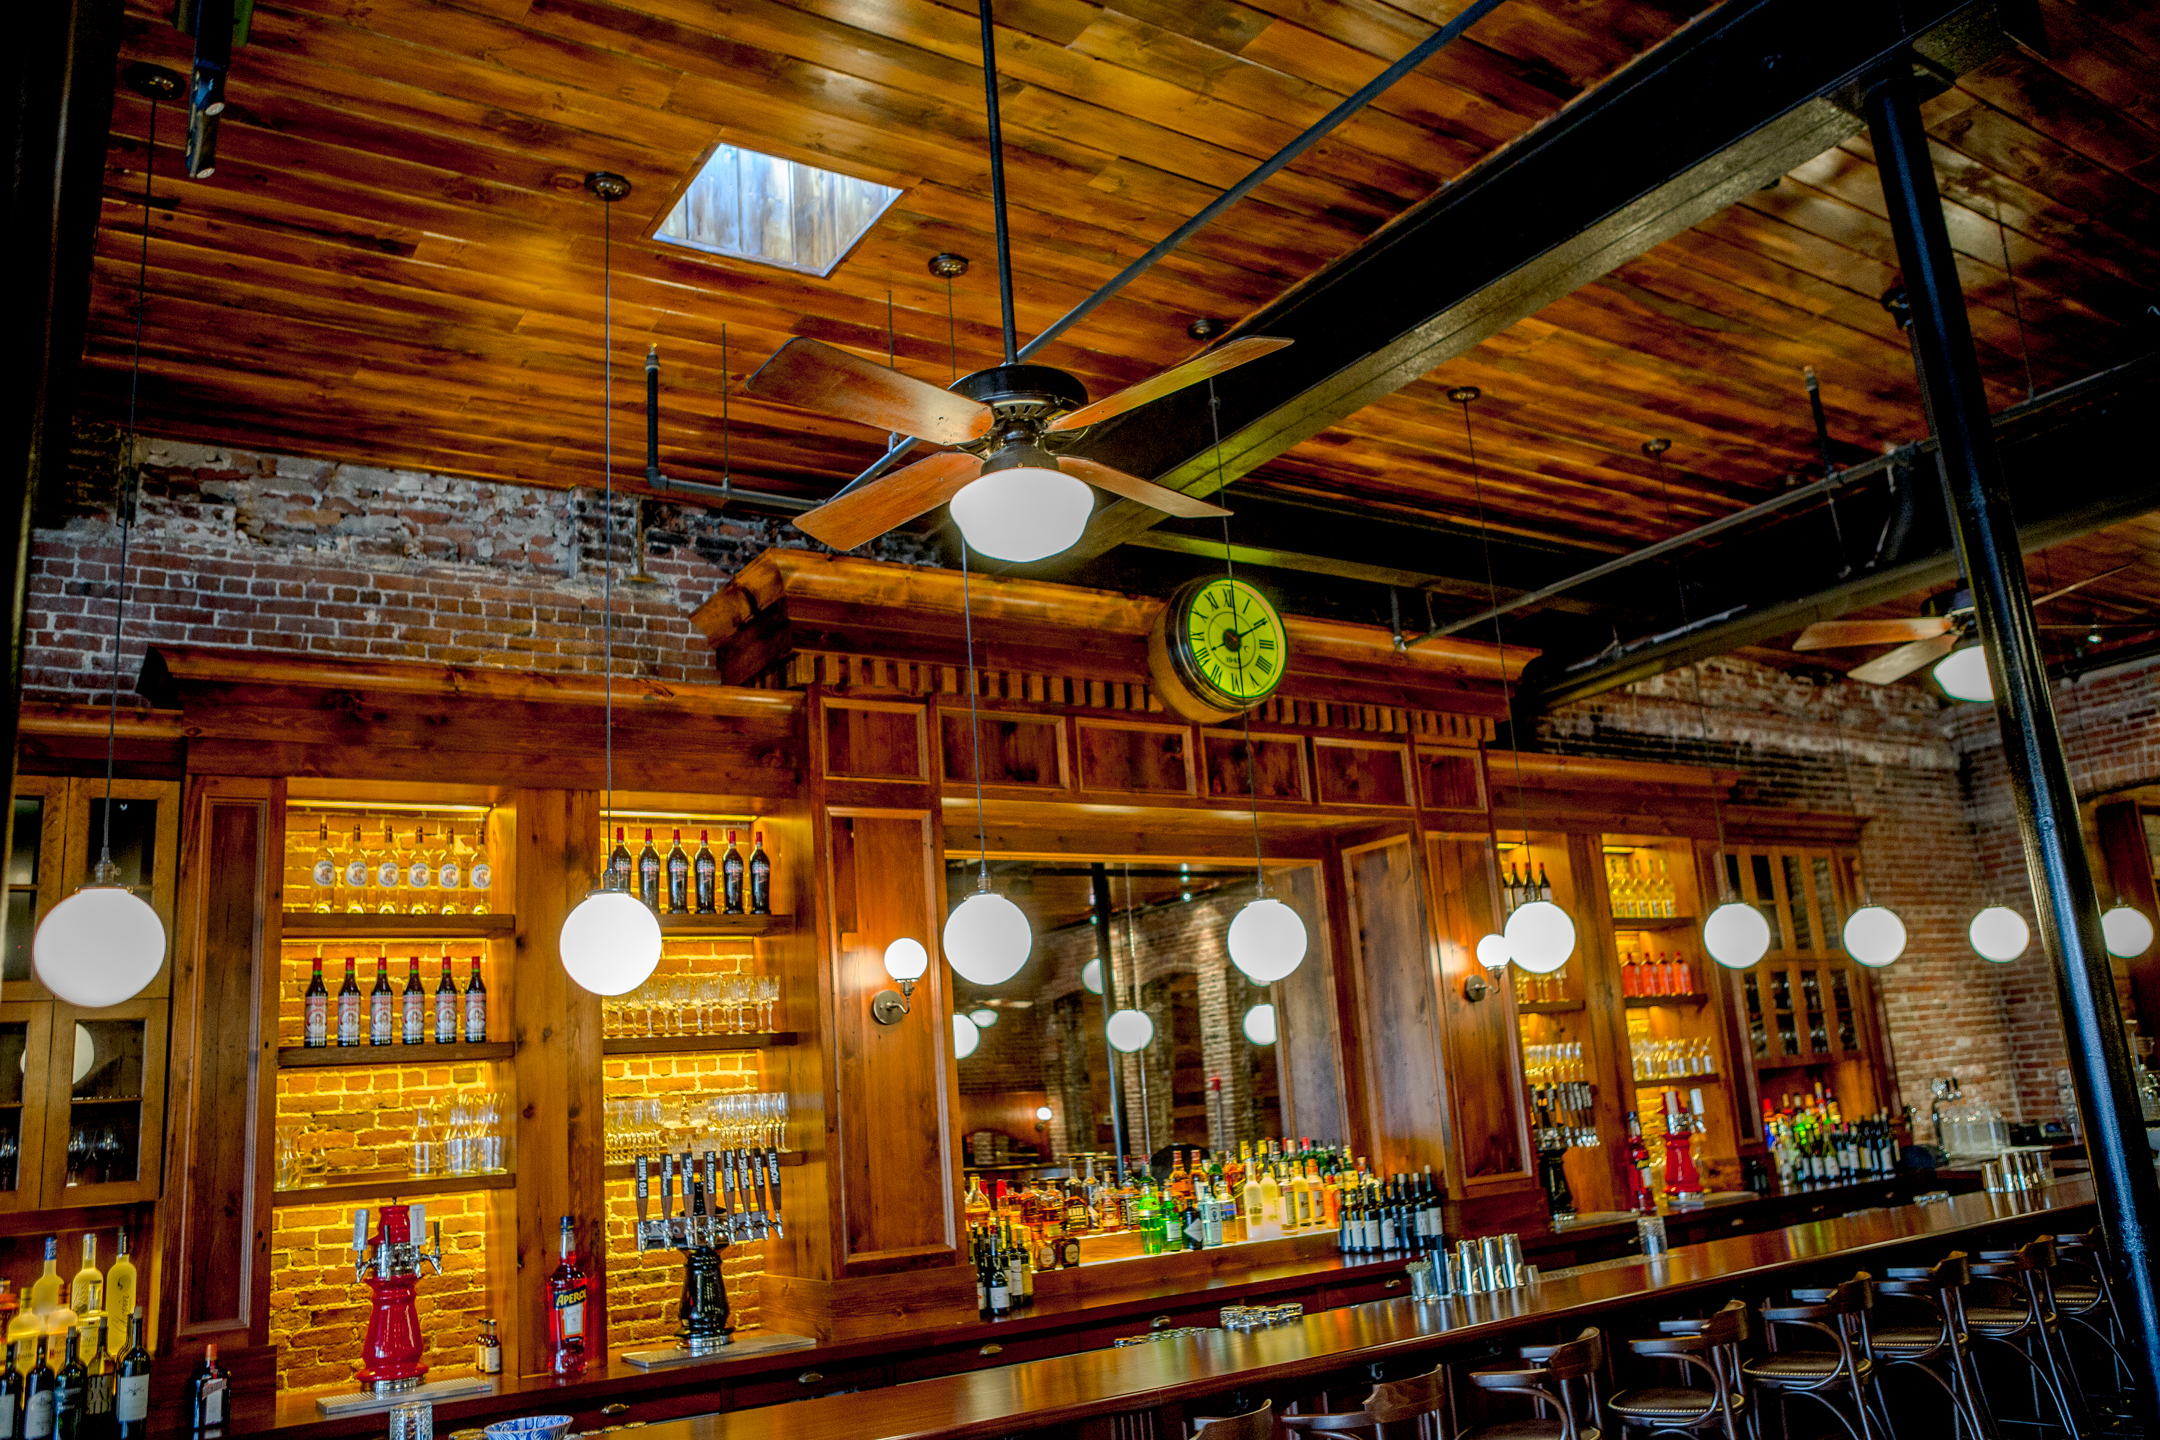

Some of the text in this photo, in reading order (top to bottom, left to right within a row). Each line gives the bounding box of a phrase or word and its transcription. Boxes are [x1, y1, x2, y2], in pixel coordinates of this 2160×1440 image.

[1204, 591, 1219, 612] XI
[1191, 606, 1208, 623] X
[1259, 639, 1275, 650] III
[768, 1152, 780, 1184] MORETTI
